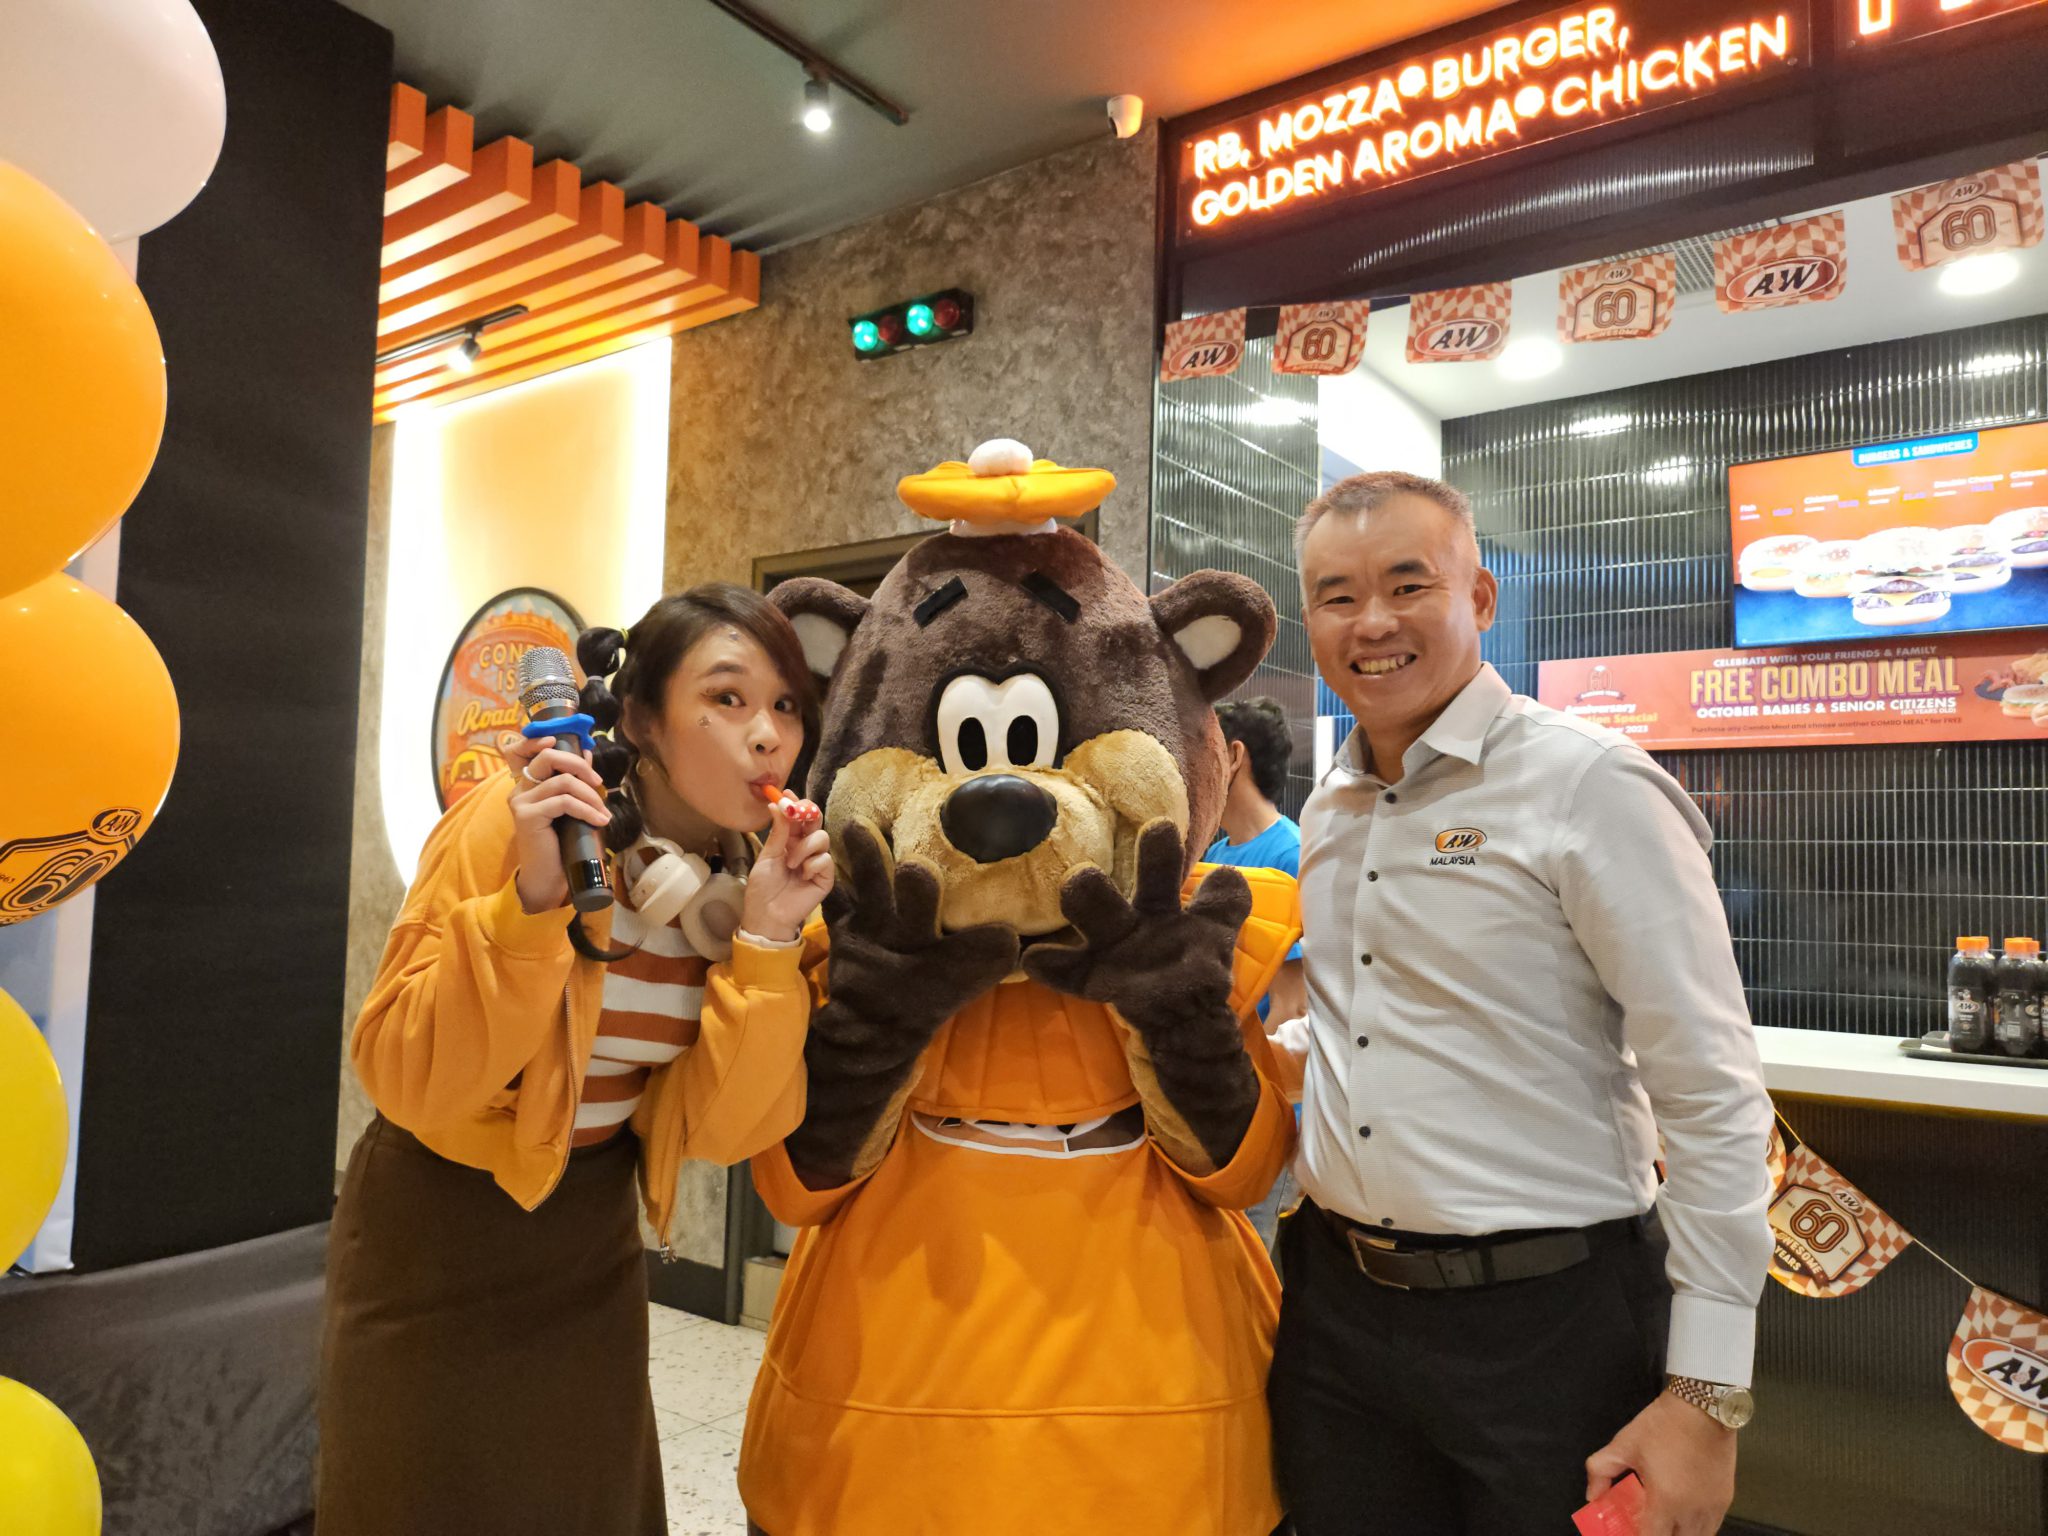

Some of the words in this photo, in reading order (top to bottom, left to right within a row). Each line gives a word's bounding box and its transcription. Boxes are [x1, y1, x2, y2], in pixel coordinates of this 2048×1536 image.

[1194, 132, 1250, 178] RB,
[1259, 77, 1404, 158] MOZZA
[1432, 8, 1629, 99] BURGER,
[1191, 150, 1344, 226] GOLDEN
[1353, 98, 1518, 179] AROMA
[1551, 15, 1787, 116] CHICKEN
[1941, 205, 1996, 251] 60
[1593, 288, 1636, 328] 60
[1301, 327, 1337, 361] 60
[480, 642, 535, 669] CON
[1712, 656, 1767, 668] CELEBRATE
[1769, 654, 1798, 664] WITH
[1800, 652, 1832, 662] YOUR
[1834, 649, 1880, 660] FRIENDS
[1883, 647, 1892, 657] &
[1896, 646, 1938, 656] FAMILY
[1690, 667, 1754, 704] FREE
[1761, 660, 1868, 700] COMBO
[1877, 656, 1960, 696] MEAL
[457, 698, 521, 736] Road
[1613, 713, 1659, 724] Special
[1696, 705, 1759, 718] OCTOBER
[1762, 703, 1811, 716] BABIES
[1814, 702, 1826, 714] &
[1830, 700, 1886, 713] SENIOR
[1889, 697, 1957, 710] CITIZENS
[1870, 719, 1902, 727] COMBO
[1429, 856, 1476, 866] MALAYSIA
[1790, 1199, 1849, 1253] 60
[1774, 1245, 1801, 1271] YEARS
